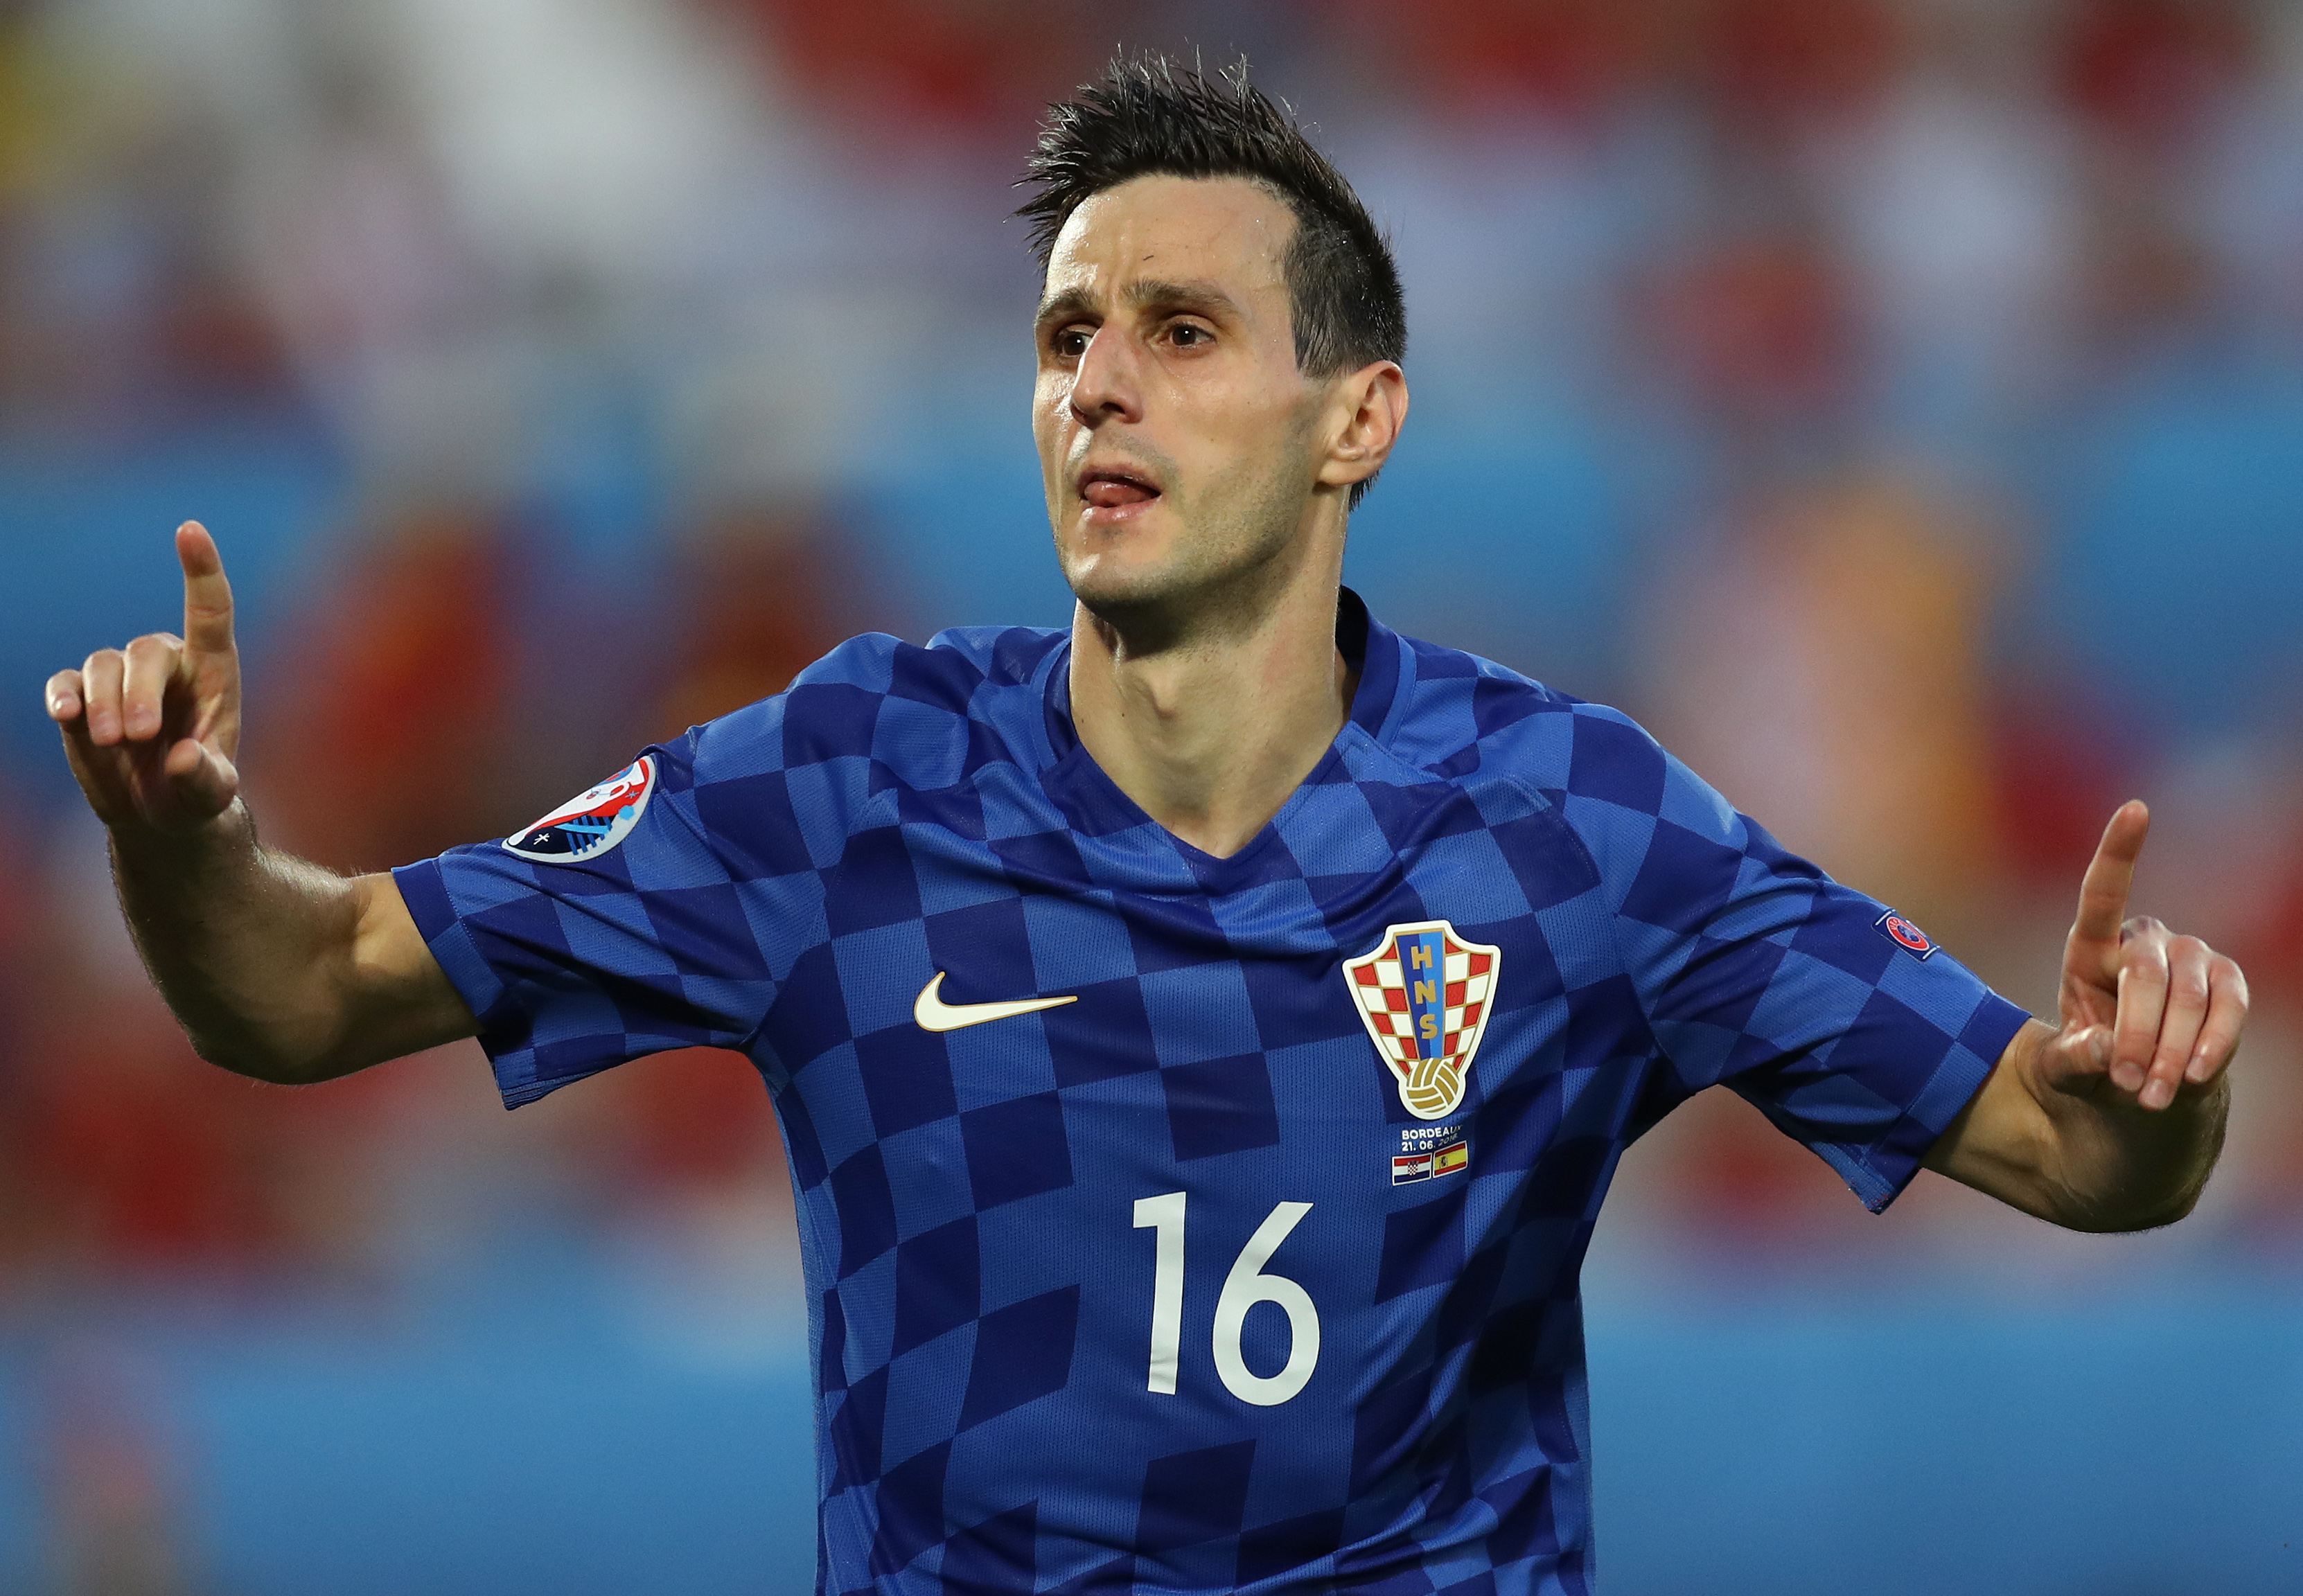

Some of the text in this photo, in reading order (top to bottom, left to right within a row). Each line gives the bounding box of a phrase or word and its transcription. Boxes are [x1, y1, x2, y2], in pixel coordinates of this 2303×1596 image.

[1411, 945, 1438, 1039] HNS
[1402, 1142, 1416, 1151] 21.
[1133, 1191, 1321, 1407] 16
